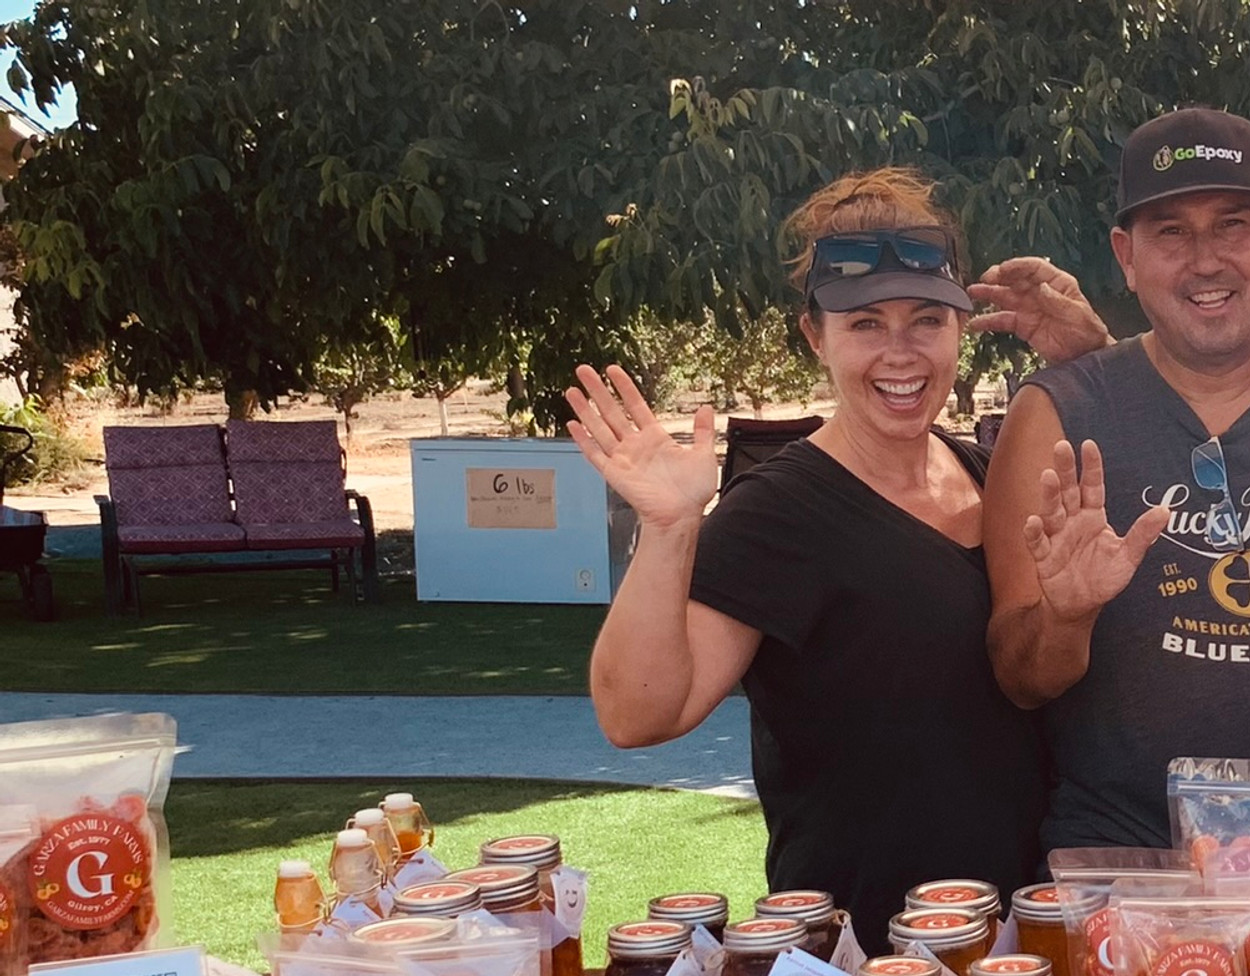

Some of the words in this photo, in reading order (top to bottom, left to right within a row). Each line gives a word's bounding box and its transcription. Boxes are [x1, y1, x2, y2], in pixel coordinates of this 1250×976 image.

[1174, 145, 1242, 163] GoEpoxy
[493, 474, 509, 493] 6
[516, 477, 535, 495] lbs
[1142, 484, 1242, 546] Lucky
[1163, 563, 1181, 577] EST.
[1158, 577, 1198, 597] 1990
[1162, 632, 1250, 661] BLUE
[34, 833, 64, 876] GARZA
[62, 819, 112, 837] FAMILY
[113, 824, 143, 864] FARMS
[66, 851, 115, 898] G
